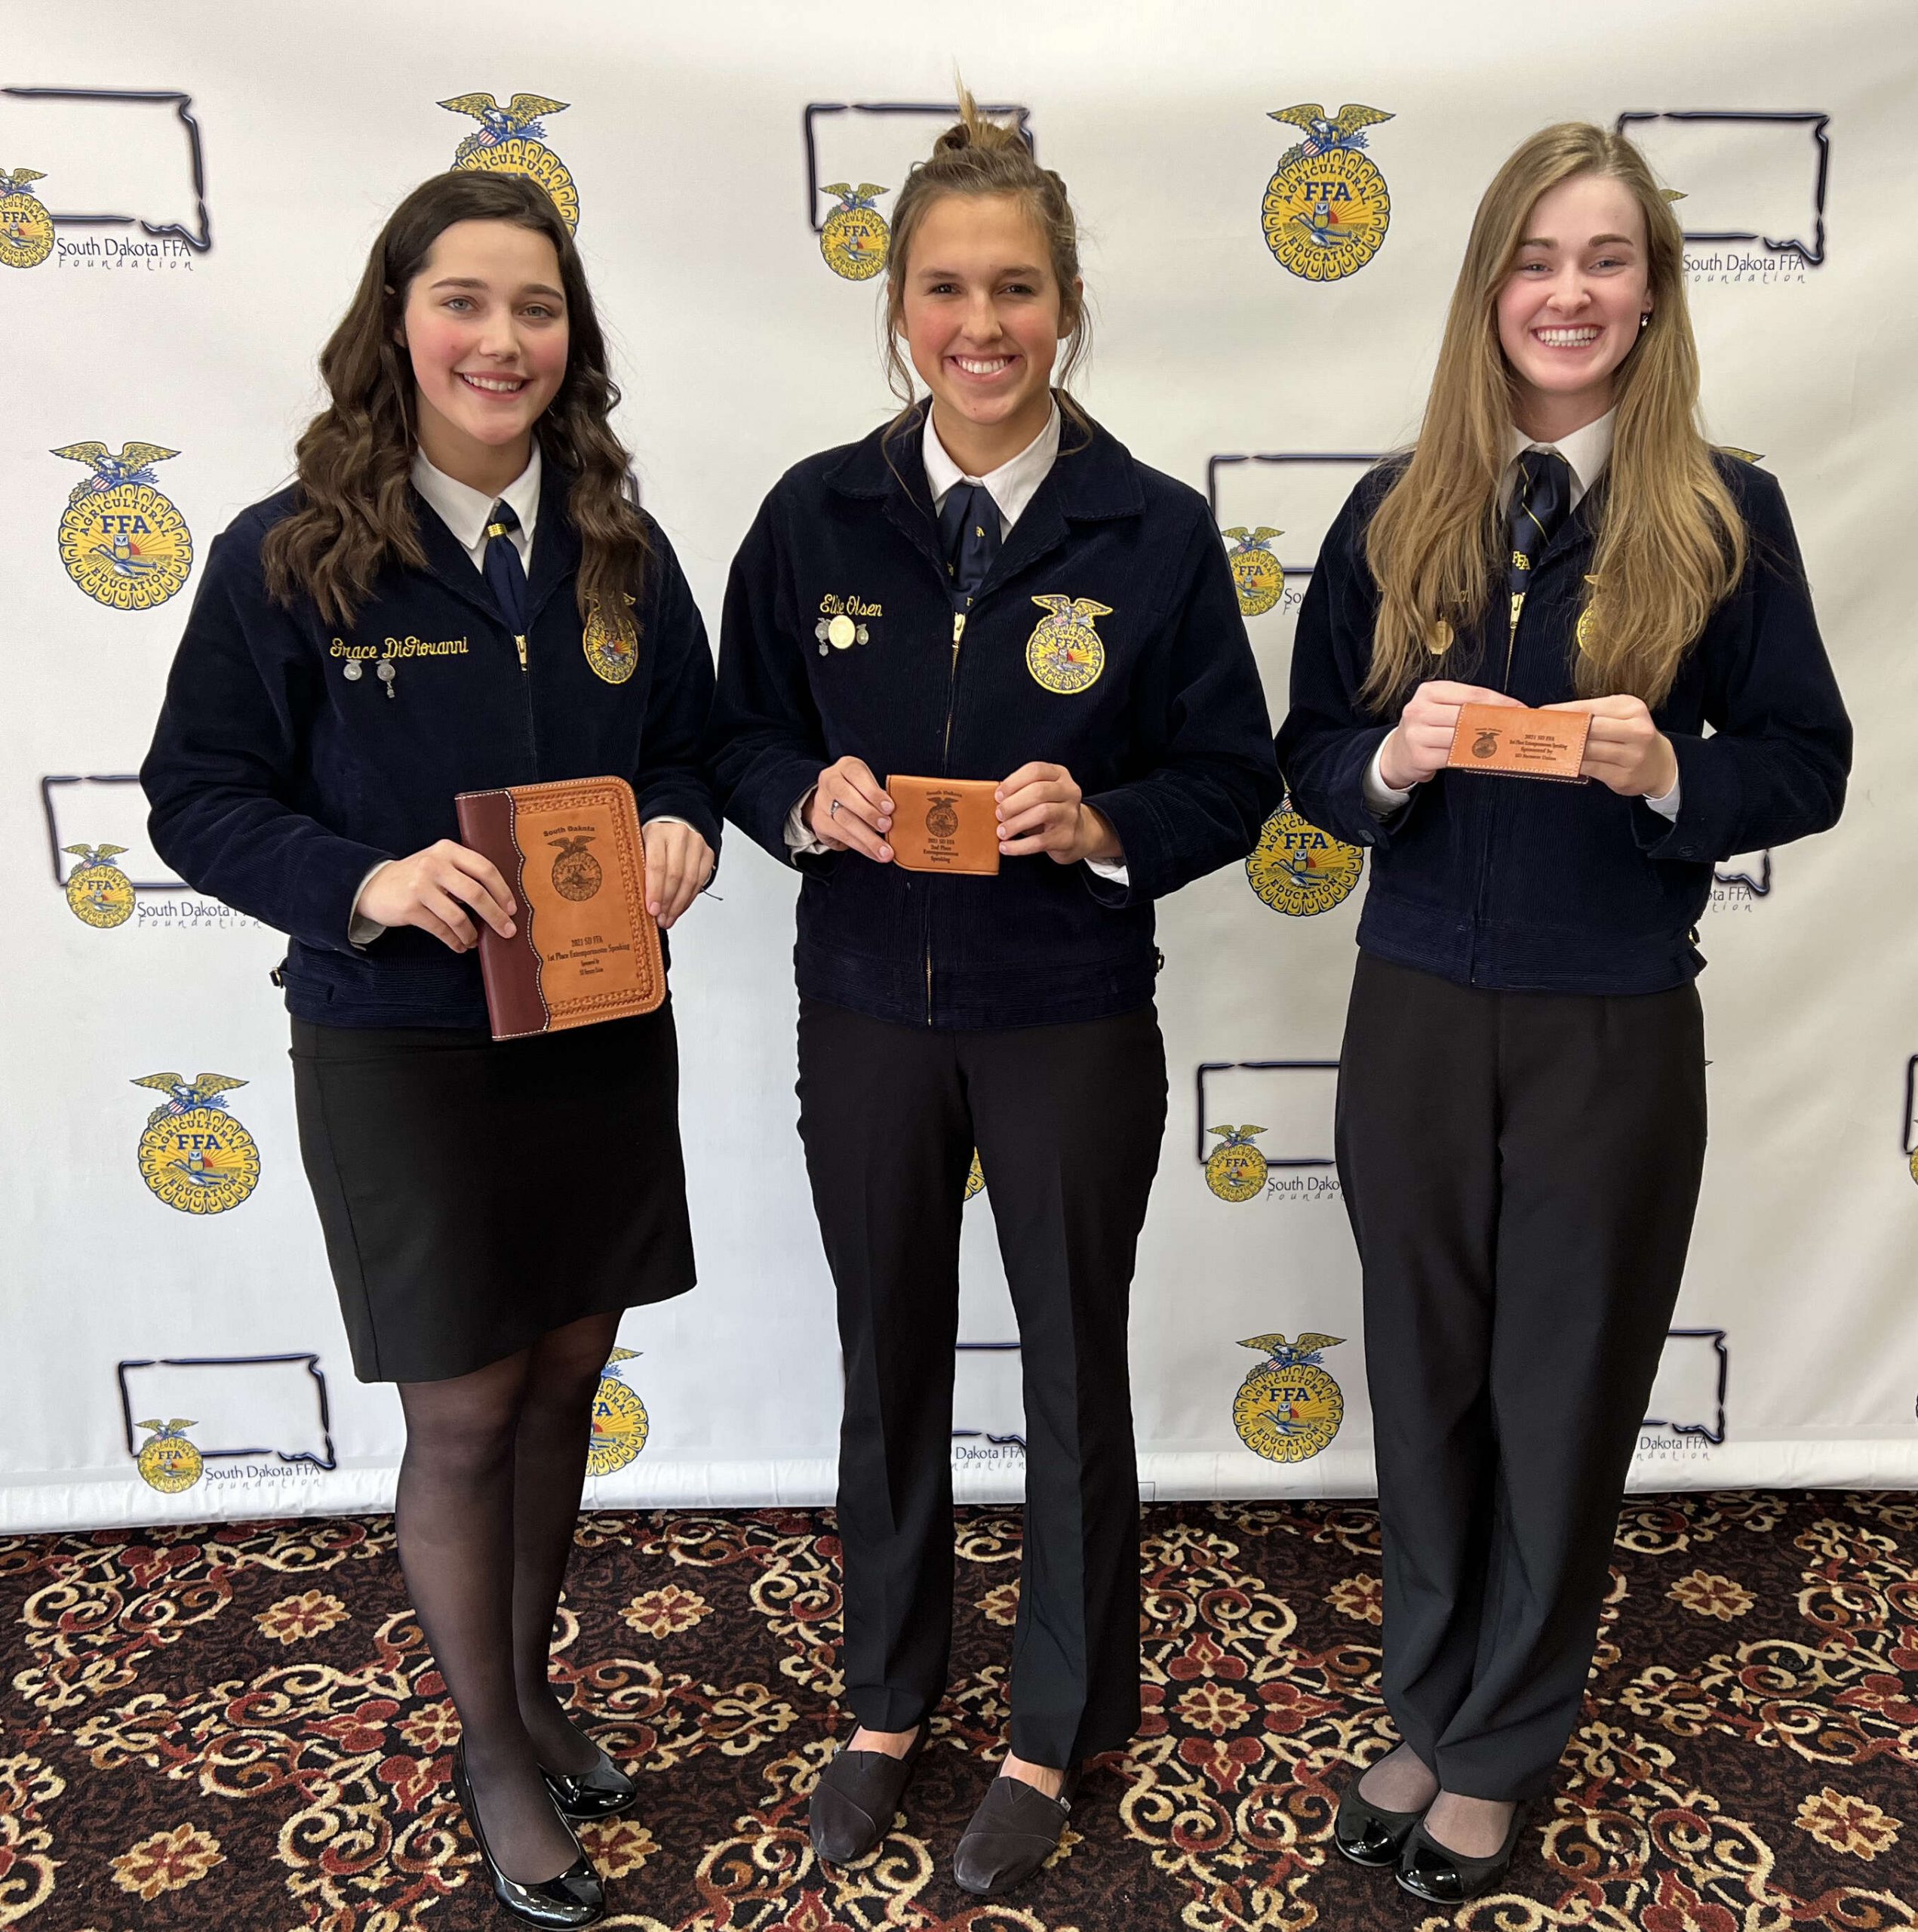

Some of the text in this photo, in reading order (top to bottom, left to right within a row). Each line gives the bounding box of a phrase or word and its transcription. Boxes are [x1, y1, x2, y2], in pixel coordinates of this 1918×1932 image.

[476, 155, 558, 196] ICULTURAL
[1283, 164, 1372, 205] AGRICULTURAL
[1304, 181, 1352, 202] FFA
[0, 202, 41, 225] ICULTURAL
[3, 211, 31, 223] FFA
[844, 226, 870, 237] FFA
[0, 243, 41, 257] DUCATION
[57, 236, 192, 257] South Dakota FFA
[1288, 235, 1363, 262] EDUCATION
[58, 254, 194, 271] Foundation
[1683, 253, 1805, 272] South Dakota FFA
[79, 498, 170, 537] AGRICULTURAL
[100, 515, 150, 534] FFA
[1232, 557, 1272, 577] RICULTURAL
[1239, 566, 1264, 575] FFA
[90, 567, 168, 592] EDUCATION
[847, 595, 883, 617] Olsen
[330, 635, 469, 659] Grace DiGiovanni
[1055, 638, 1081, 650] FFA
[543, 826, 566, 837] South
[1265, 818, 1345, 852] AGRICUL
[1284, 832, 1328, 849] FFA
[88, 880, 114, 891] FFA
[1271, 878, 1338, 900] EDUCATION
[1729, 886, 1752, 900] FFA
[137, 901, 177, 918] South
[181, 900, 230, 917] Dakota
[138, 915, 263, 929] Foundation
[158, 1119, 241, 1153] AGRICULTURAL
[176, 1134, 223, 1149] FFA
[1225, 1158, 1249, 1167] FFA
[169, 1177, 238, 1198] EDUCATION
[1267, 1176, 1340, 1192] South Dako
[1266, 1189, 1345, 1201] Founda
[1251, 1375, 1326, 1404] AGRICULTURAL
[1268, 1387, 1311, 1401] FFA
[1256, 1426, 1320, 1447] EDUCATION
[1640, 1435, 1707, 1449] Dakota FFA
[158, 1451, 183, 1460] FFA
[955, 1445, 1025, 1460] Dakota FFA
[1637, 1449, 1711, 1461] ndation
[204, 1463, 321, 1481] South Dakota FFA
[951, 1459, 1026, 1472] ndation
[204, 1478, 321, 1492] Foundation
